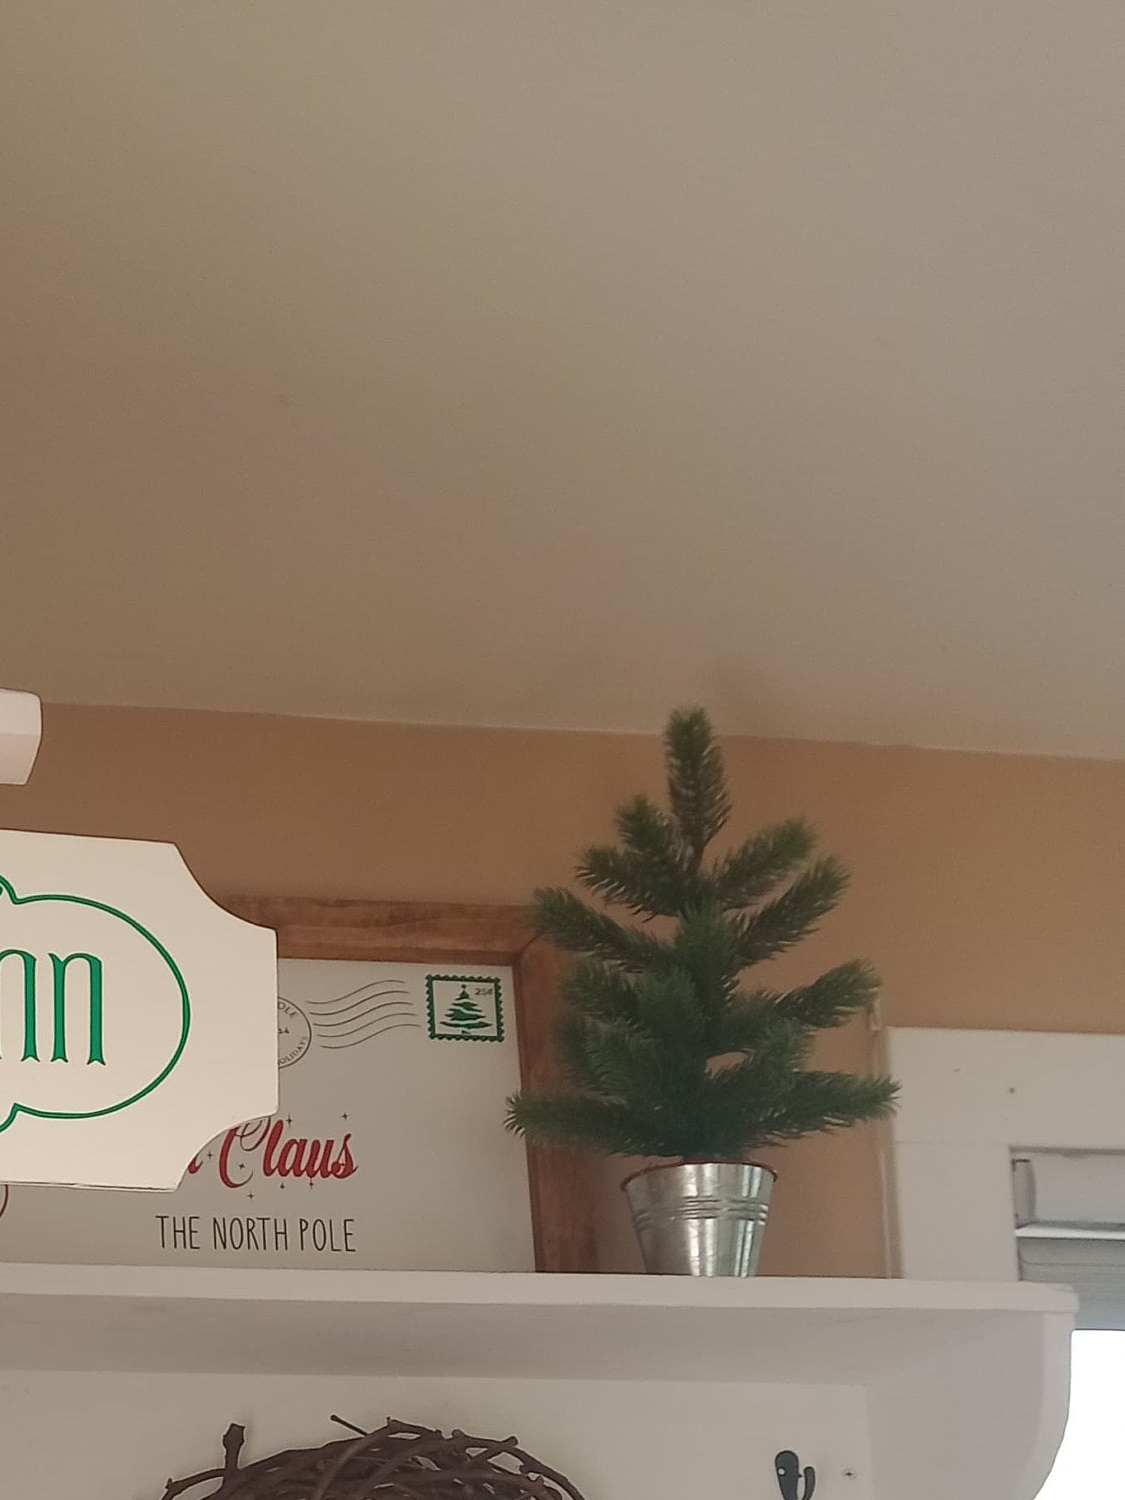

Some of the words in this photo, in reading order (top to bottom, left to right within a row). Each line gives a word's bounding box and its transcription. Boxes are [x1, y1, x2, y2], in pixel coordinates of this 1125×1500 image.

[219, 1116, 358, 1188] Claus
[155, 1215, 201, 1250] THE
[213, 1217, 288, 1251] NORTH
[299, 1218, 356, 1252] POLE
